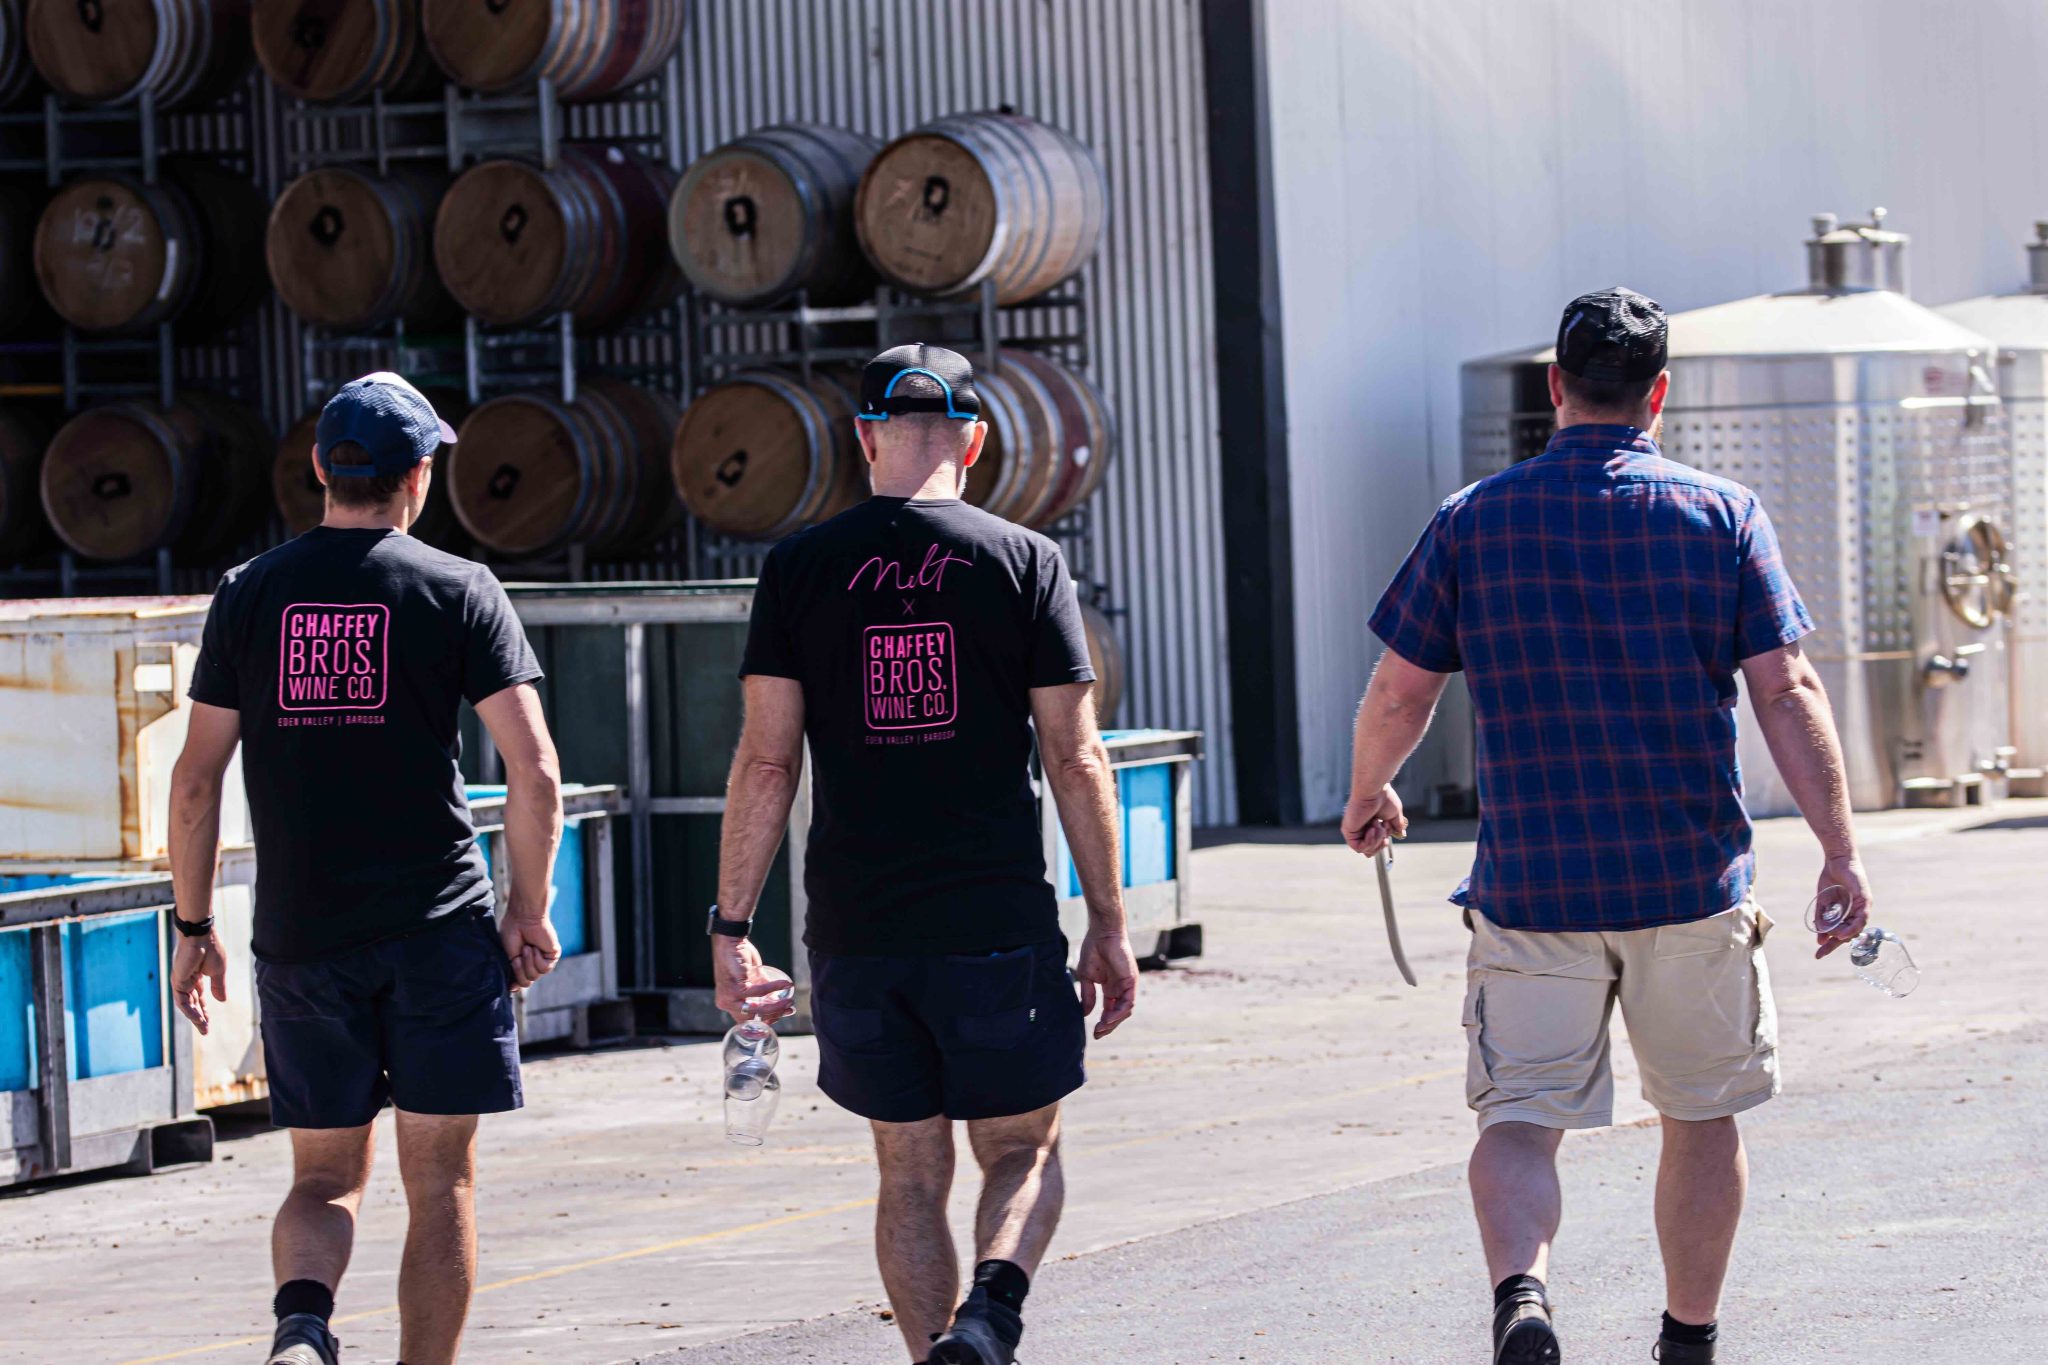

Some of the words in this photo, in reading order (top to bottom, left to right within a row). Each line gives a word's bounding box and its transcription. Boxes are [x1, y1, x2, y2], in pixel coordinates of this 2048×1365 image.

[290, 613, 380, 638] CHAFFEY
[288, 639, 377, 675] BROS.
[869, 631, 947, 659] CHAFFEY
[288, 676, 340, 700] WINE
[347, 675, 376, 699] CO.
[870, 657, 948, 695] BROS.
[871, 695, 917, 719] WINE
[923, 692, 949, 717] CO.
[277, 717, 299, 727] EDEN
[302, 716, 335, 726] VALLEY
